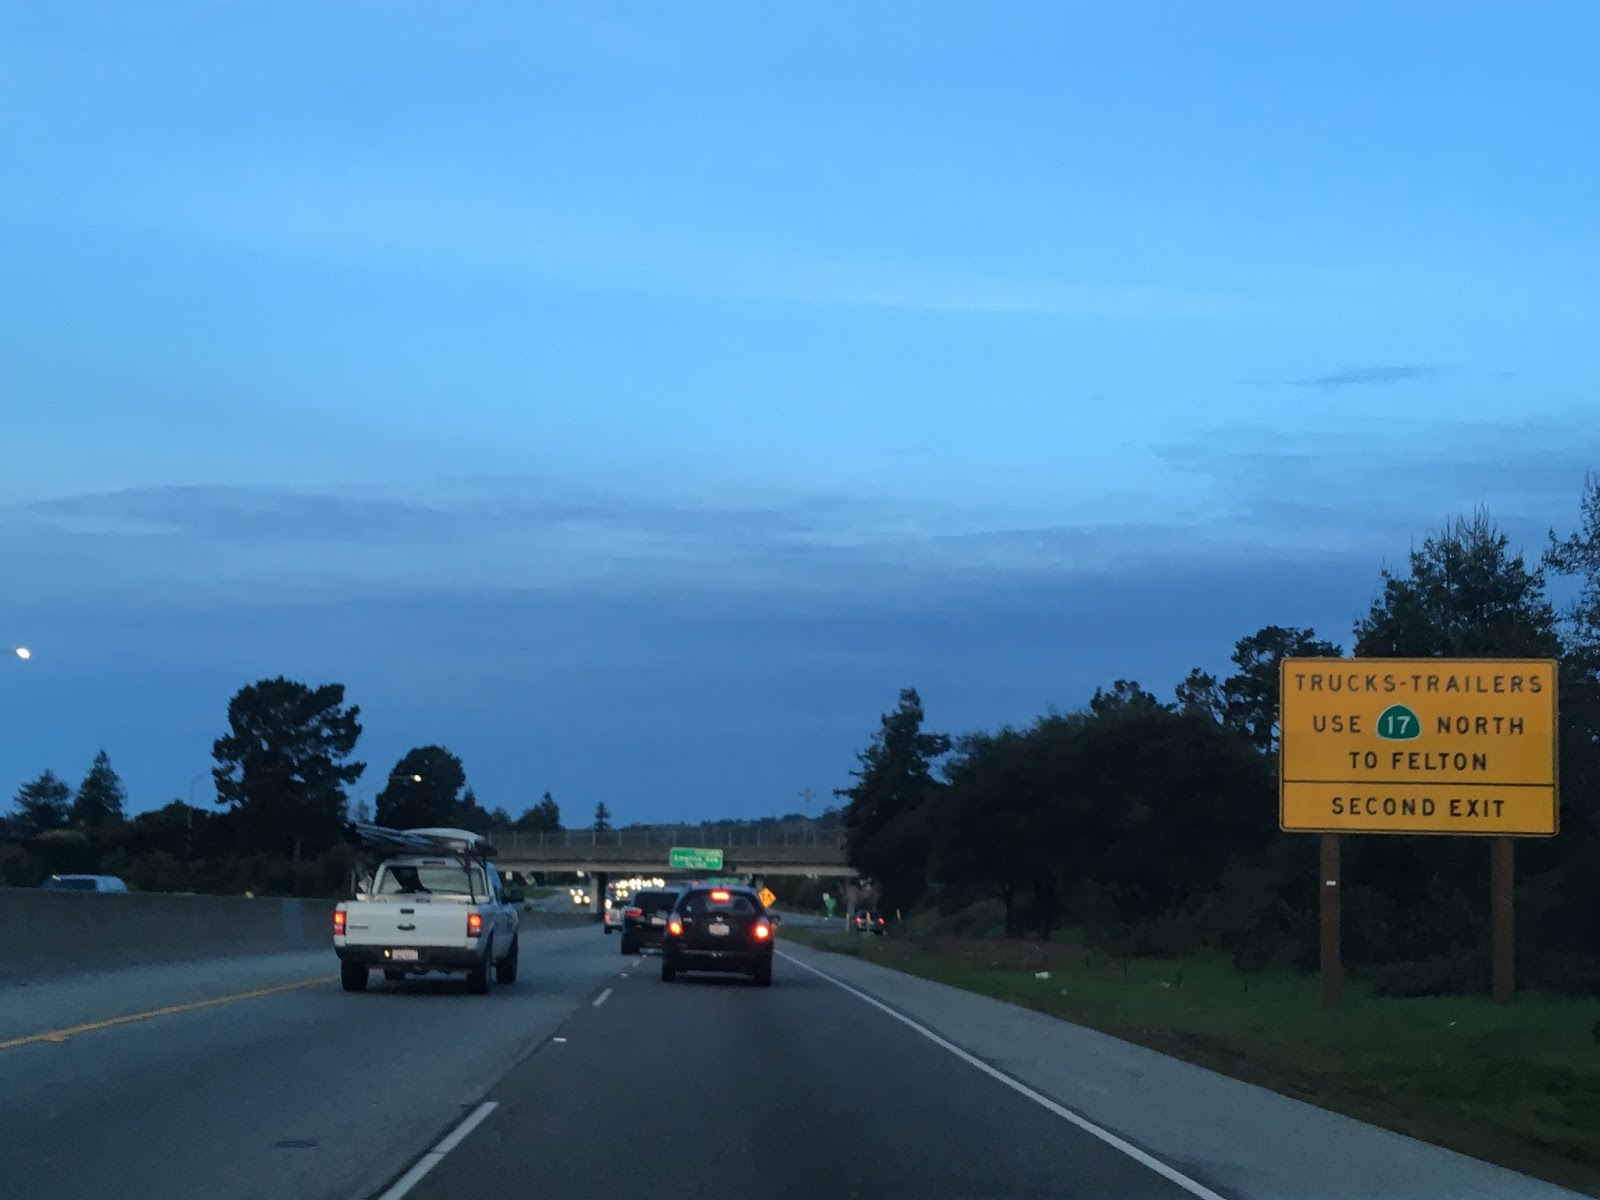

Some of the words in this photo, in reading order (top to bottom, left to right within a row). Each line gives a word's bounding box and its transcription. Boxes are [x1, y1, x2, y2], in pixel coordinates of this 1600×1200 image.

[1295, 673, 1544, 694] TRUCKS-TRAILERS
[1312, 714, 1362, 734] USE
[1386, 715, 1411, 735] 17
[1436, 715, 1525, 735] NORTH
[1349, 751, 1378, 769] TO
[1391, 752, 1488, 771] FELTON
[1331, 797, 1436, 817] SECOND
[1449, 799, 1506, 818] EXIT
